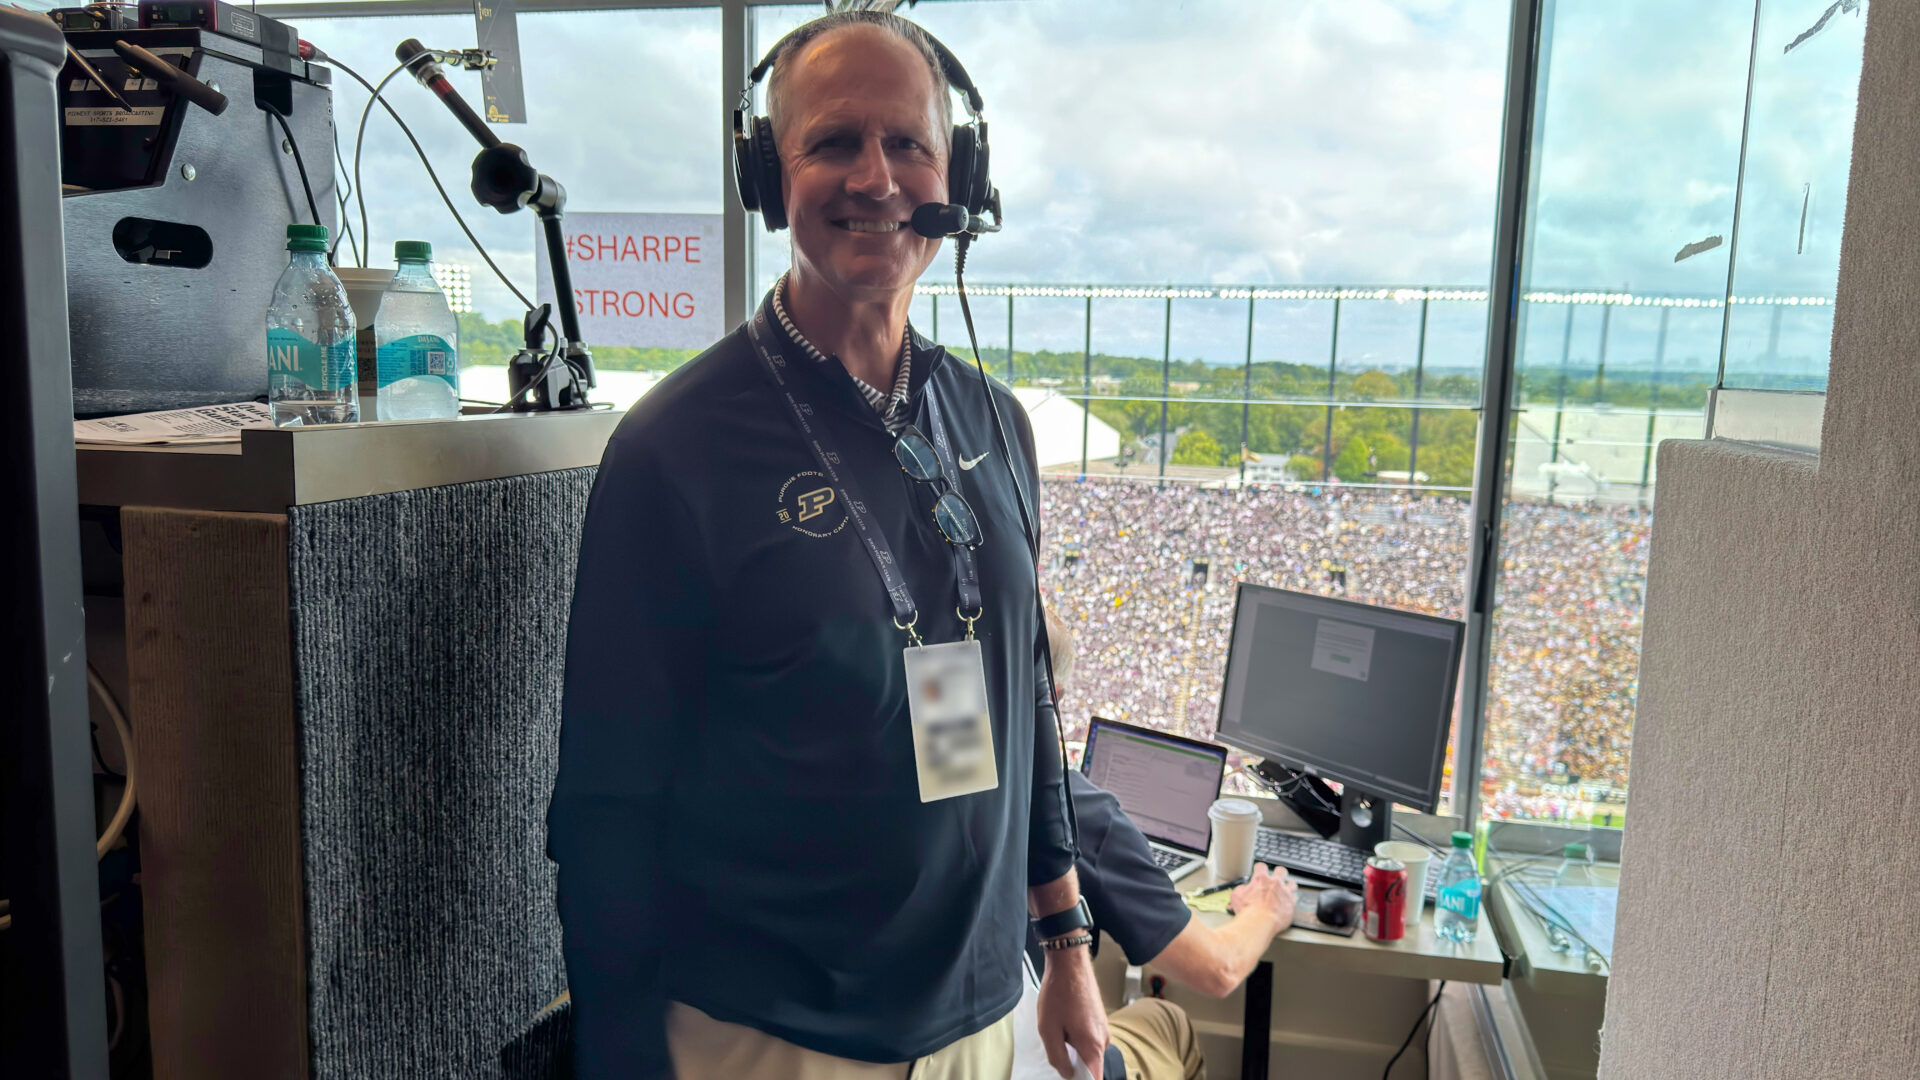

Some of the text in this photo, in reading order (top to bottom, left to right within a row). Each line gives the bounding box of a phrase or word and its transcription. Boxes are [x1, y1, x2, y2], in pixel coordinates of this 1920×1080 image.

[566, 234, 702, 263] #SHARPE
[195, 408, 245, 427] Guide
[215, 406, 262, 423] Start
[235, 404, 273, 421] Quic
[778, 470, 824, 503] PURDUE FOOTB
[797, 486, 835, 523] P
[792, 525, 832, 539] HONORARY
